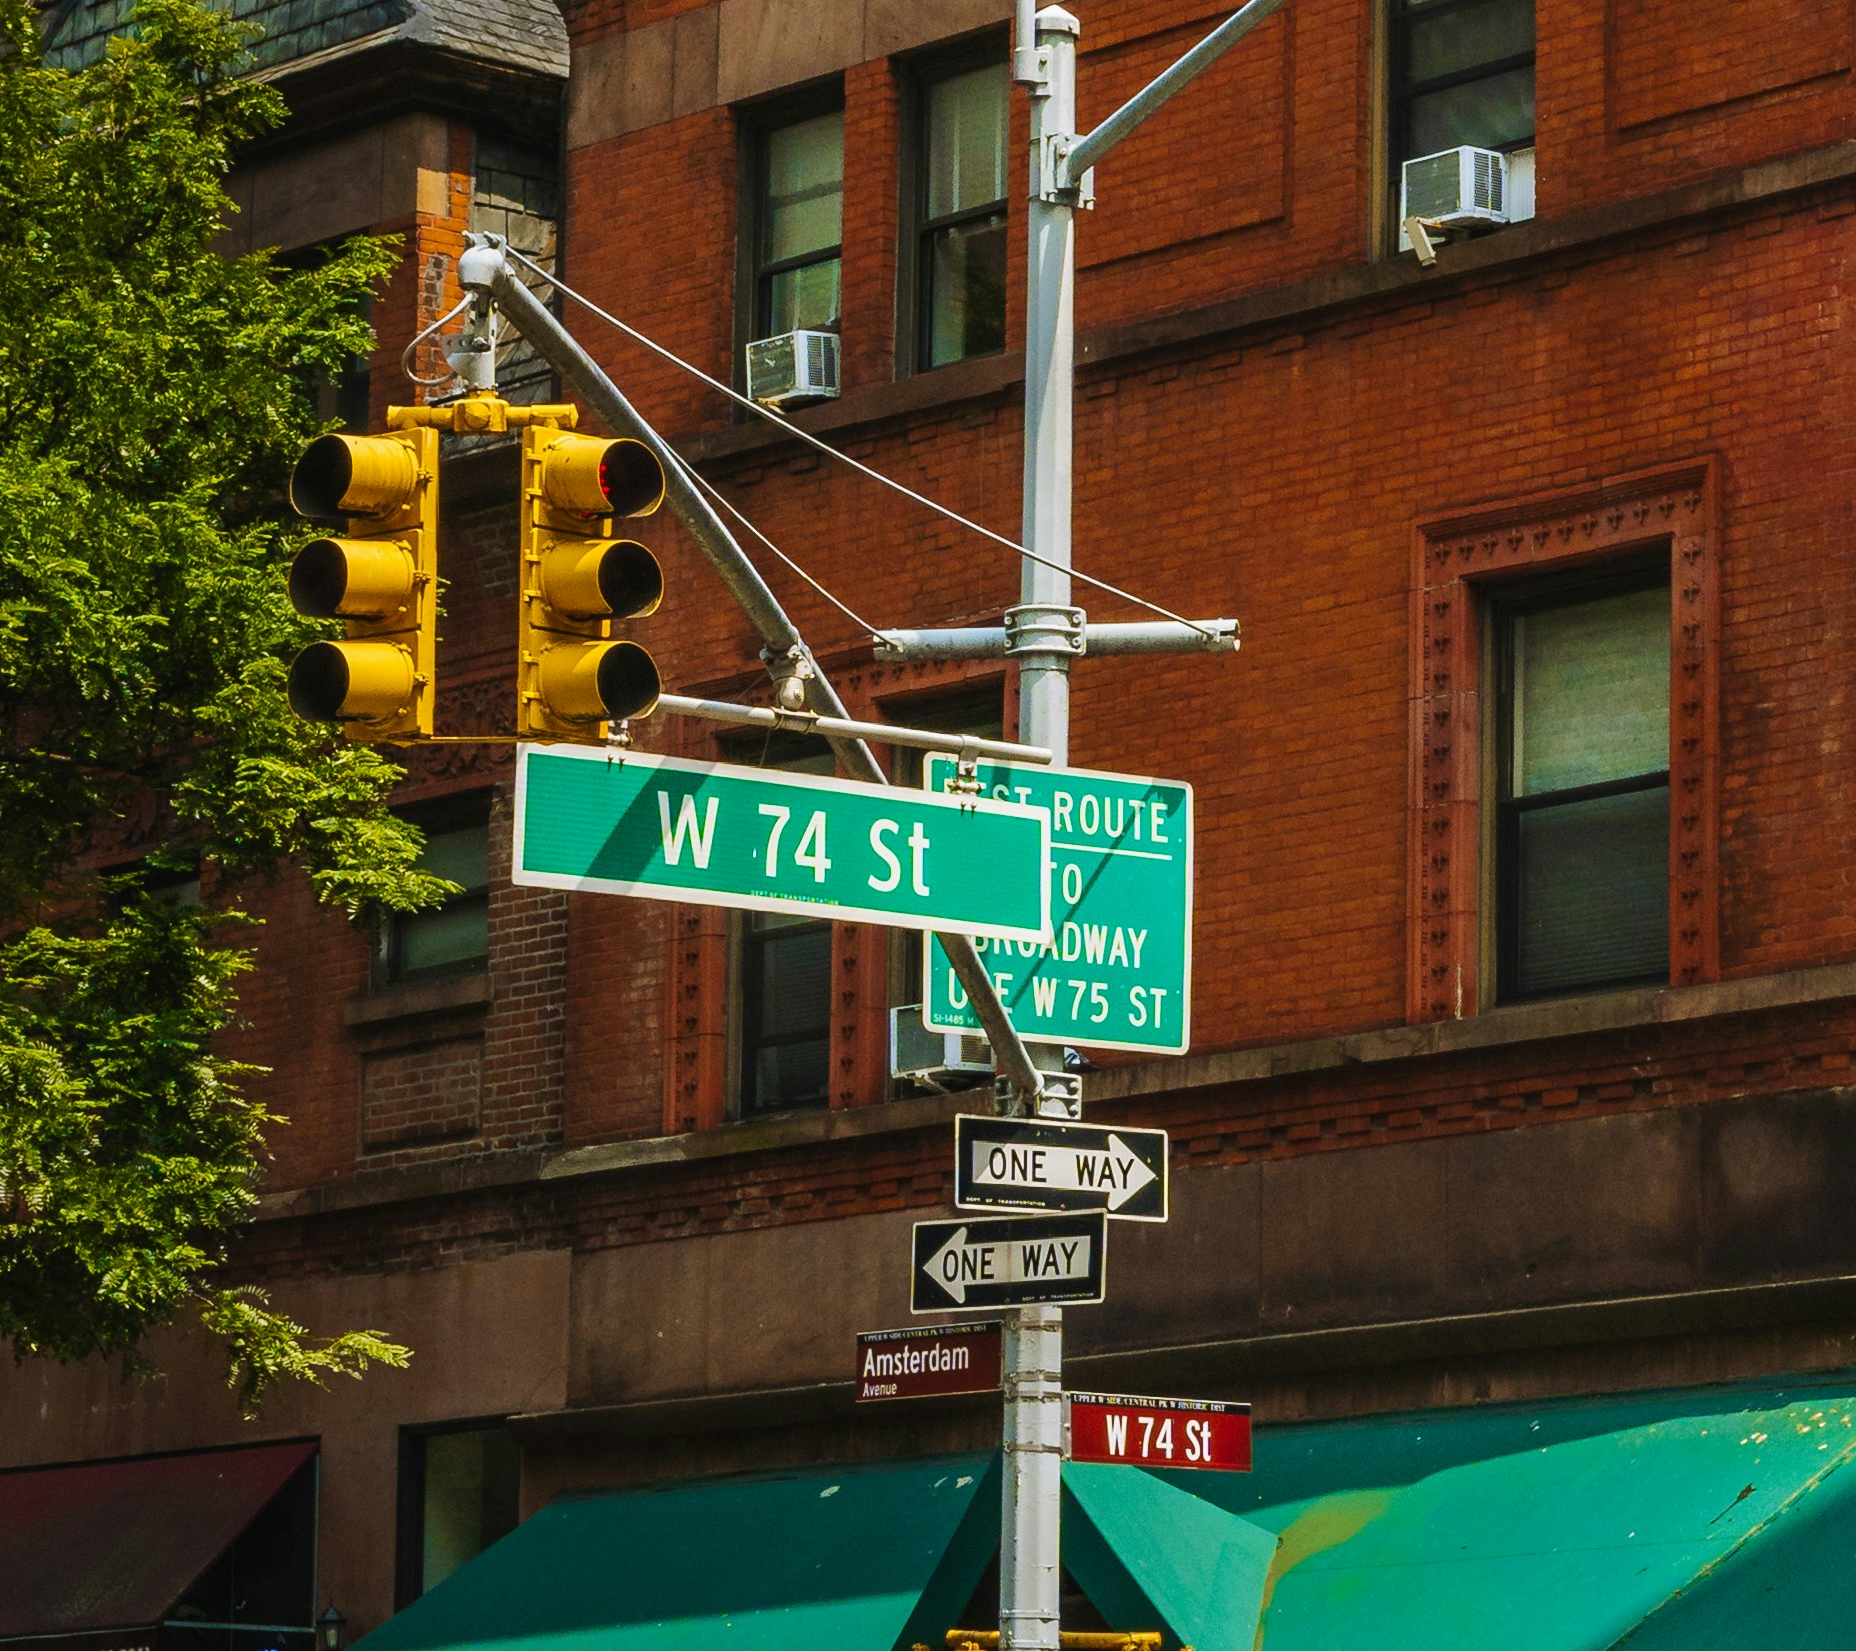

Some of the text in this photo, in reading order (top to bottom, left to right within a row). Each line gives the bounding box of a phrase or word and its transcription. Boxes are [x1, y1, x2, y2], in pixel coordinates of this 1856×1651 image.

[1053, 791, 1169, 843] ROUTE
[657, 791, 930, 898] W 74 St
[948, 968, 1013, 1014] UE
[1129, 986, 1168, 1028] ST
[988, 1147, 1134, 1190] ONE WAY
[943, 1241, 1079, 1282] ONE WAY
[863, 1342, 969, 1378] Amsterdam
[863, 1382, 897, 1397] Avenue
[1106, 1414, 1212, 1462] W 74 St
